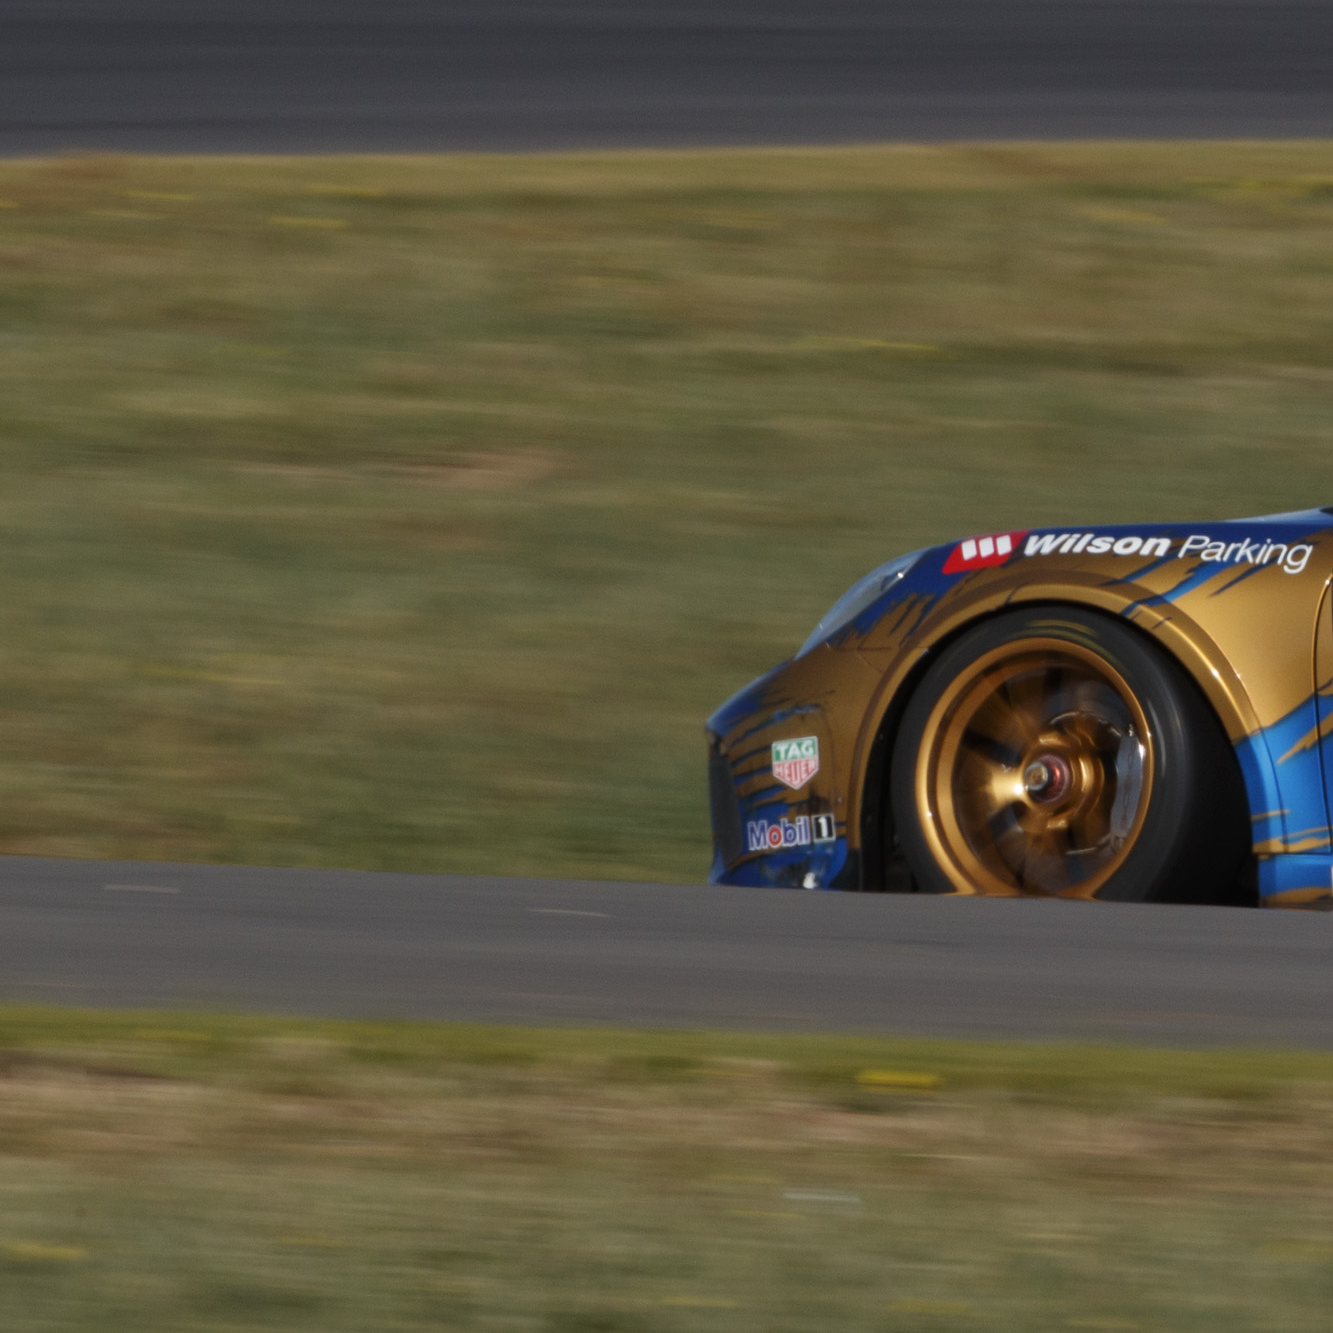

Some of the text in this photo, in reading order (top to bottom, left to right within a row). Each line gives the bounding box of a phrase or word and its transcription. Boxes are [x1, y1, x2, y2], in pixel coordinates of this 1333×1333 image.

[1023, 533, 1314, 575] Wilson Parking
[775, 739, 815, 760] TAG
[774, 759, 817, 786] HEUER
[747, 815, 811, 851] Mobil
